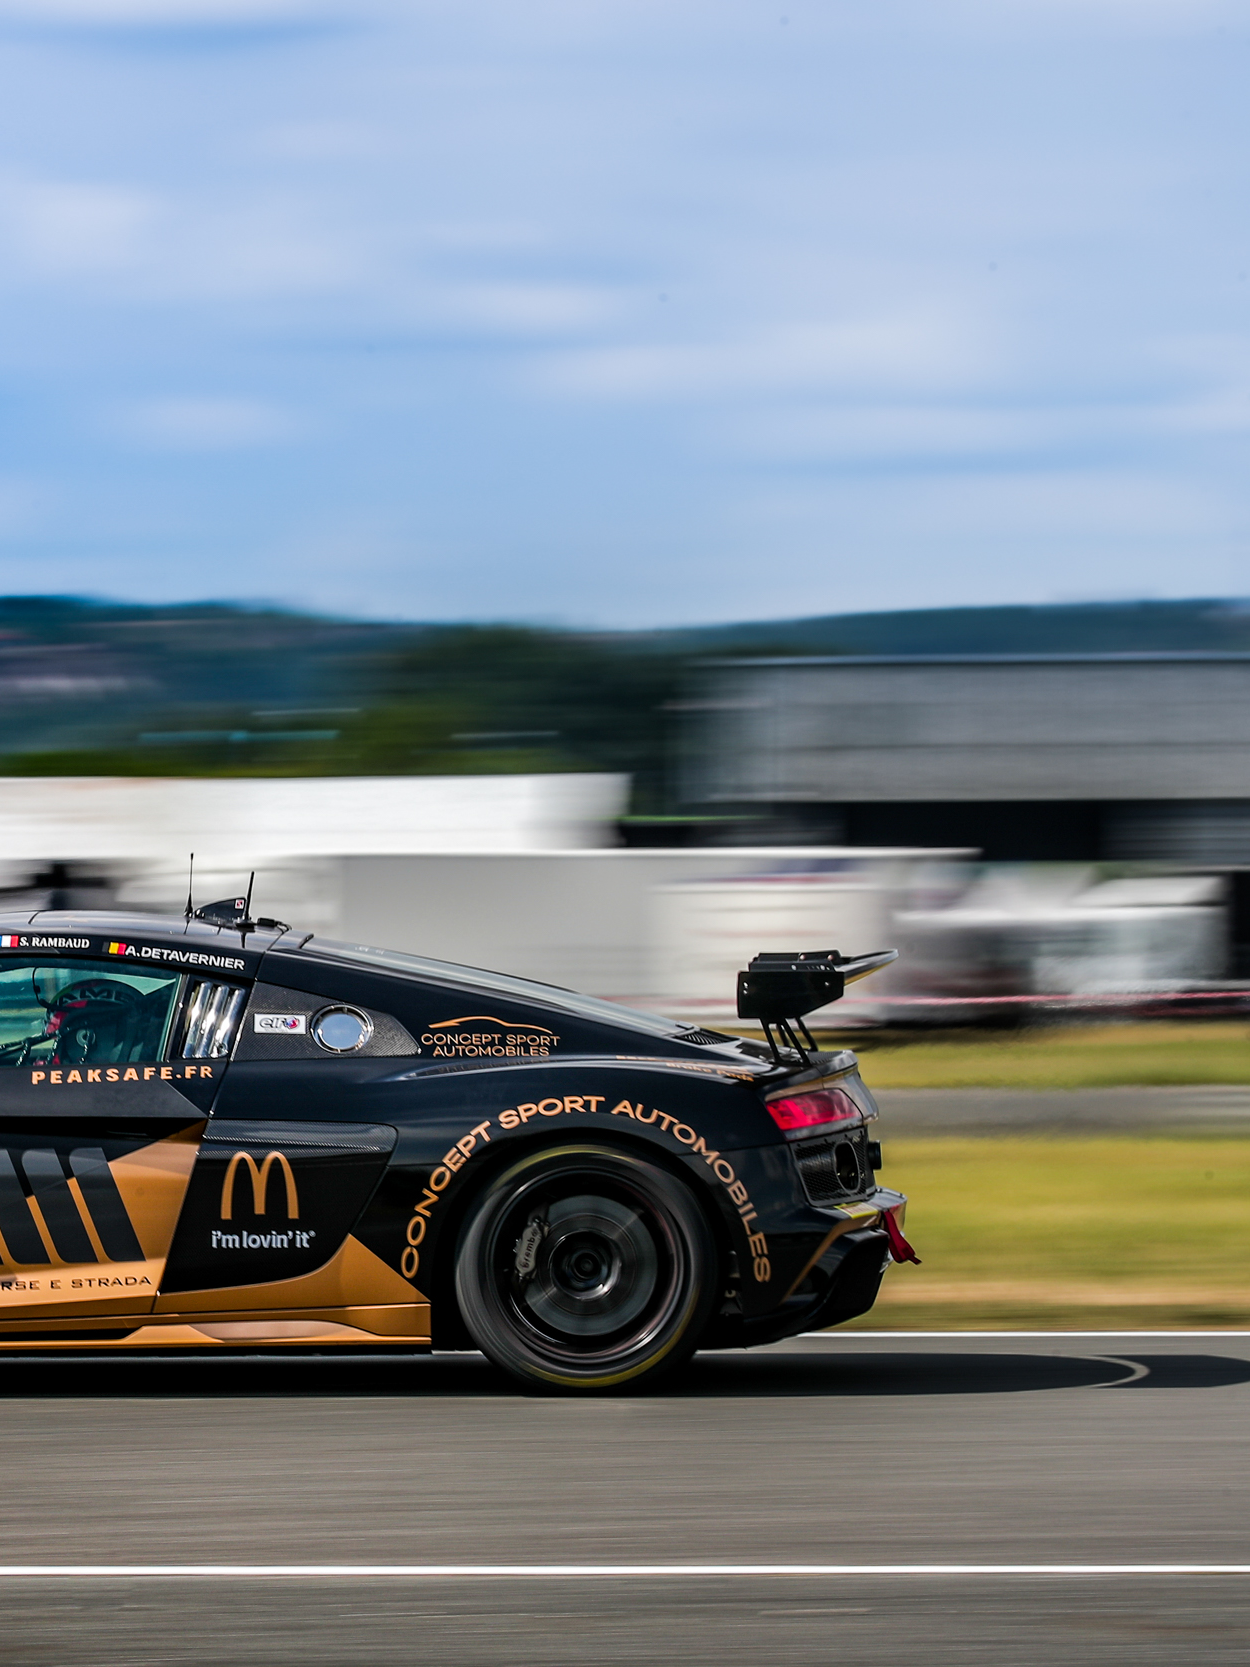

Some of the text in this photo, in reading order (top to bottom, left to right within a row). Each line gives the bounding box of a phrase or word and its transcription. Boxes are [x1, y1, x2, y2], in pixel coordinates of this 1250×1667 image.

[18, 936, 90, 949] S. RAMBAUD
[420, 1033, 561, 1047] CONCEPT SPORT
[432, 1045, 550, 1058] AUTOMOBILES
[31, 1065, 214, 1085] PEAKSAFE.FR
[401, 1095, 772, 1284] CONCEPT SPORT AUTOMOBILES
[211, 1230, 240, 1249] i'm
[242, 1230, 294, 1250] lovin'
[519, 1227, 540, 1269] brembo
[49, 1279, 63, 1291] E
[71, 1275, 152, 1290] STRADA
